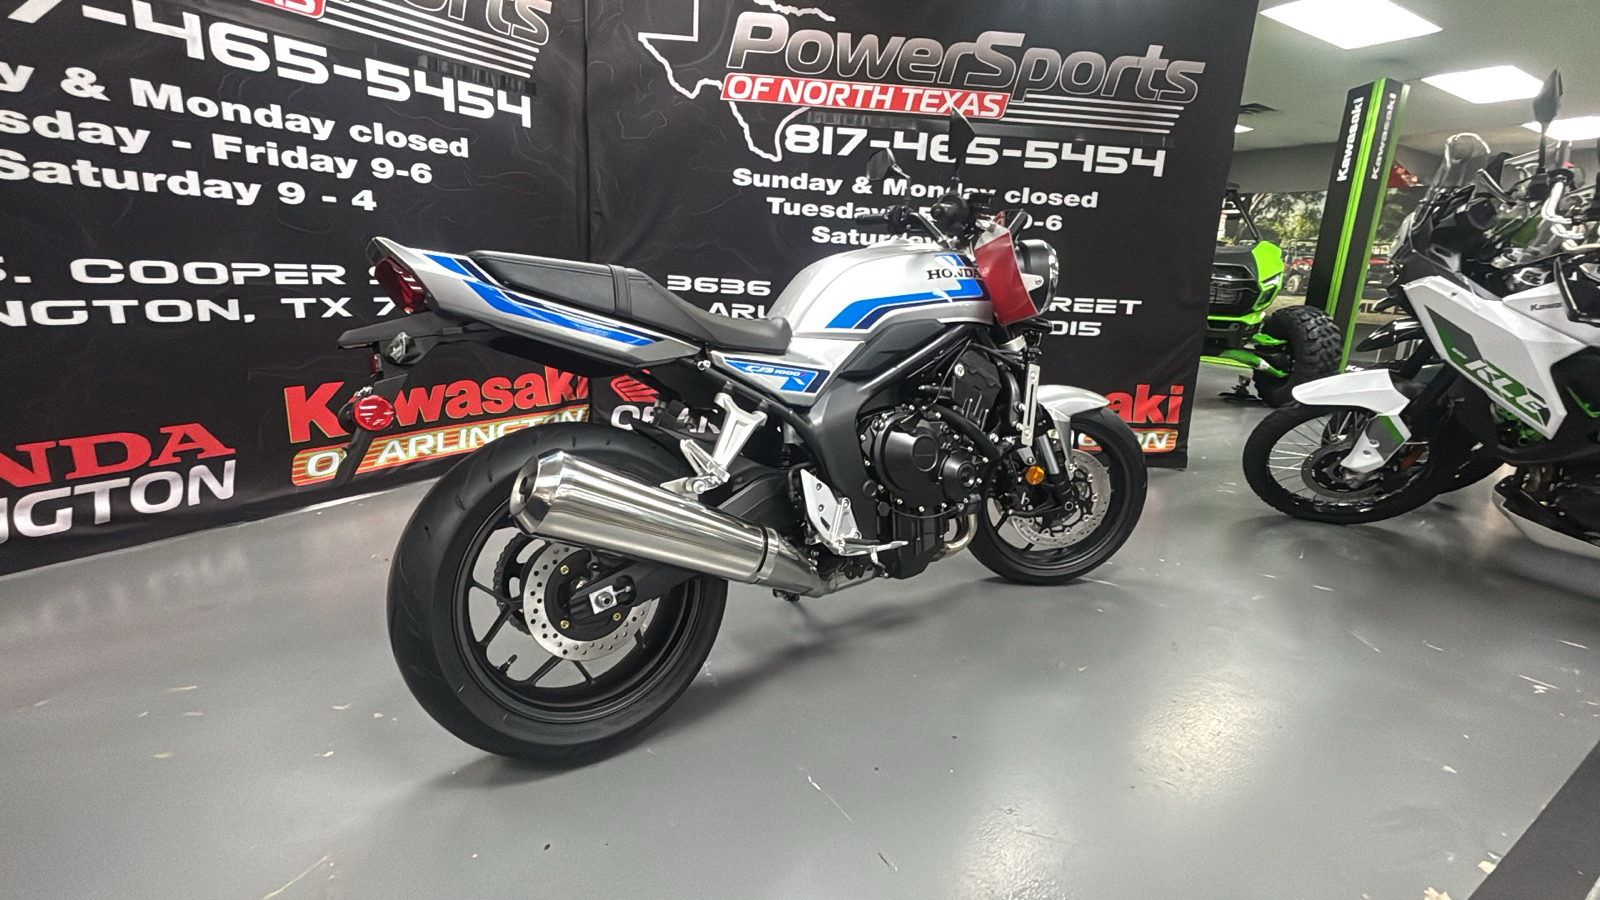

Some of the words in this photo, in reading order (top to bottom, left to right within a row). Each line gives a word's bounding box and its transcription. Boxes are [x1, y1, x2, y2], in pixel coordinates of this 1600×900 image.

[726, 11, 1206, 104] PowerSports
[60, 67, 111, 101] &
[130, 78, 336, 141] Monday
[349, 122, 469, 158] closed
[727, 76, 774, 100] OF
[777, 79, 895, 109] NORTH
[902, 88, 1002, 116] TEXAS
[171, 139, 192, 149] -
[212, 133, 358, 179] Friday
[370, 157, 433, 184] 9-6
[1336, 96, 1365, 182] Kawasaki
[1371, 92, 1397, 180] Kawasaki
[0, 149, 262, 206] Saturday
[277, 182, 306, 205] 9
[321, 195, 337, 203] -
[351, 190, 377, 211] 4
[732, 168, 843, 195] Sunday
[851, 176, 873, 194] &
[1004, 187, 1099, 208] closed
[70, 258, 347, 285] COOPER
[667, 274, 771, 296] 3636
[1049, 296, 1142, 315] REET
[926, 268, 983, 280] HONDA
[280, 297, 353, 319] TX
[284, 365, 588, 444] Kwasaki
[0, 459, 236, 545] GTON
